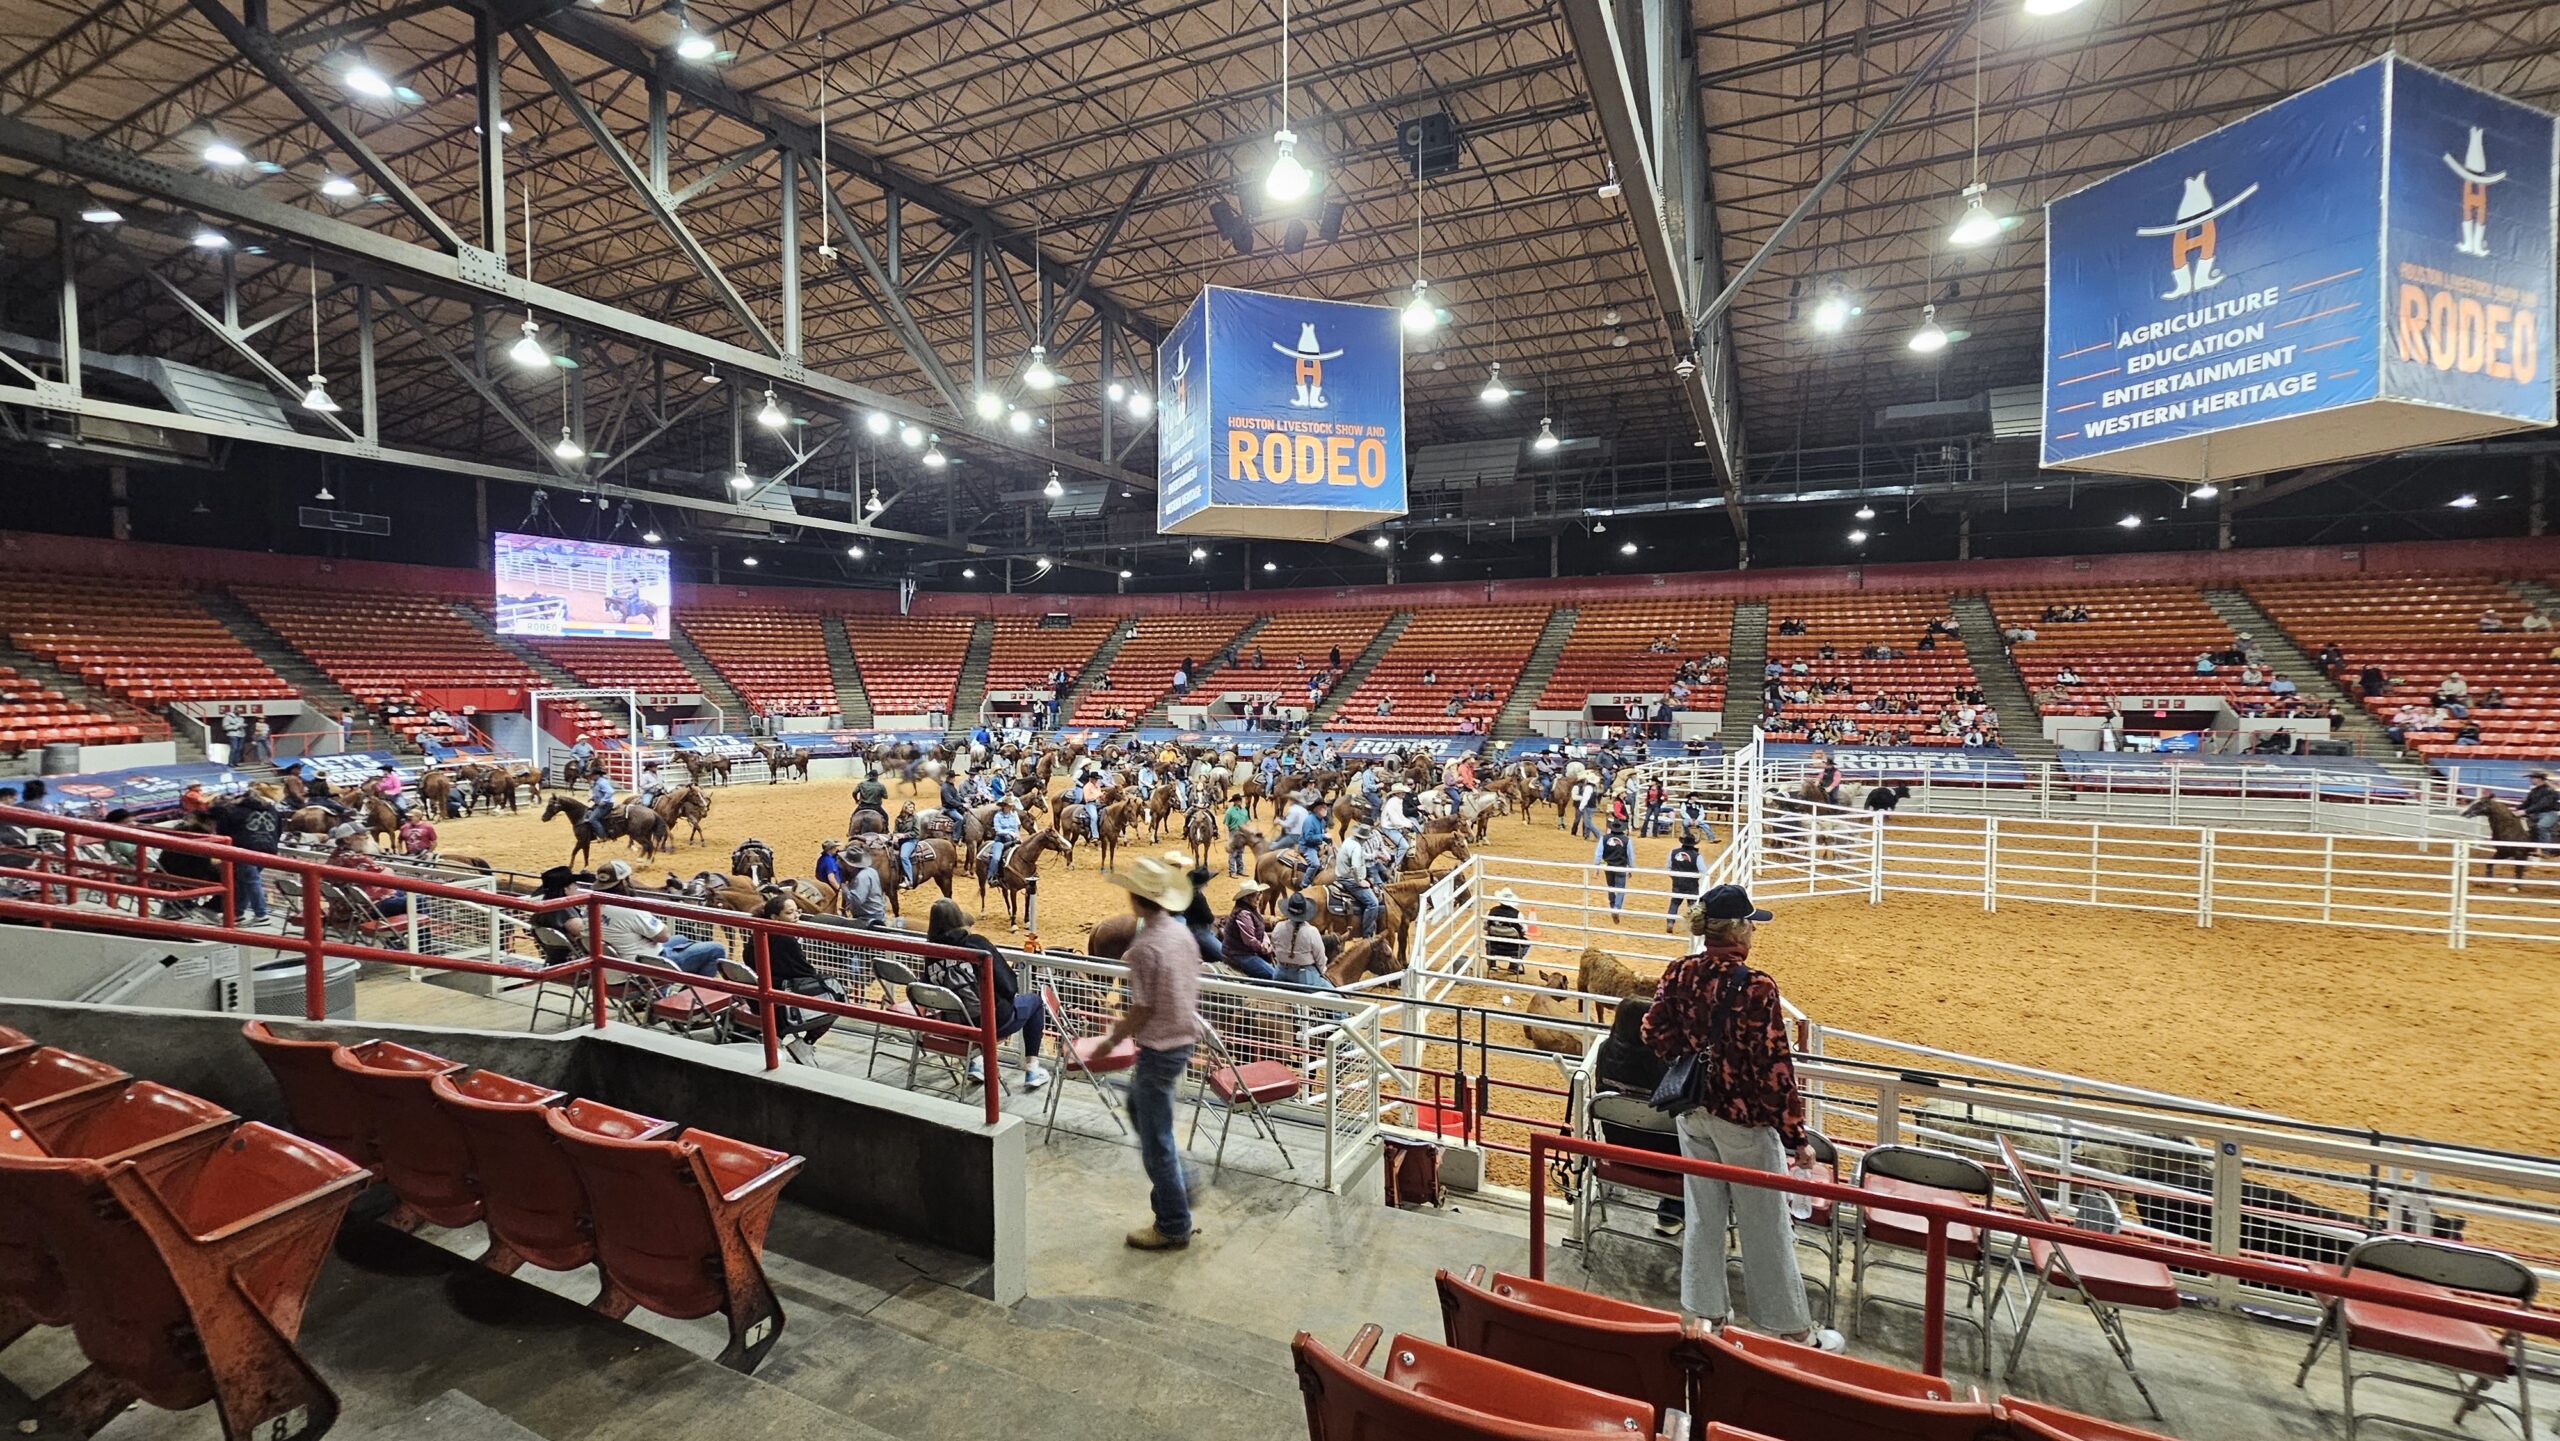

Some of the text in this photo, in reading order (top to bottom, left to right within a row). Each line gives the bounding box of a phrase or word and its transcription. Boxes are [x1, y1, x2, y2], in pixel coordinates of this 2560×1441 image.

[2117, 286, 2279, 349] AGRICULTURE
[2399, 283, 2537, 385] RODEO
[2127, 322, 2265, 374] EDUCATION
[2102, 344, 2297, 408] ENTERTAINMENT
[1228, 416, 1385, 437] HOUSTON LIVESTOCK SHOW AND
[2085, 371, 2317, 439] WESTERN HERITAGE
[1228, 430, 1386, 488] RODEO
[527, 622, 557, 632] RODEO
[300, 754, 383, 771] LET'S
[1834, 754, 1969, 770] RODEO
[271, 1416, 288, 1441] 8
